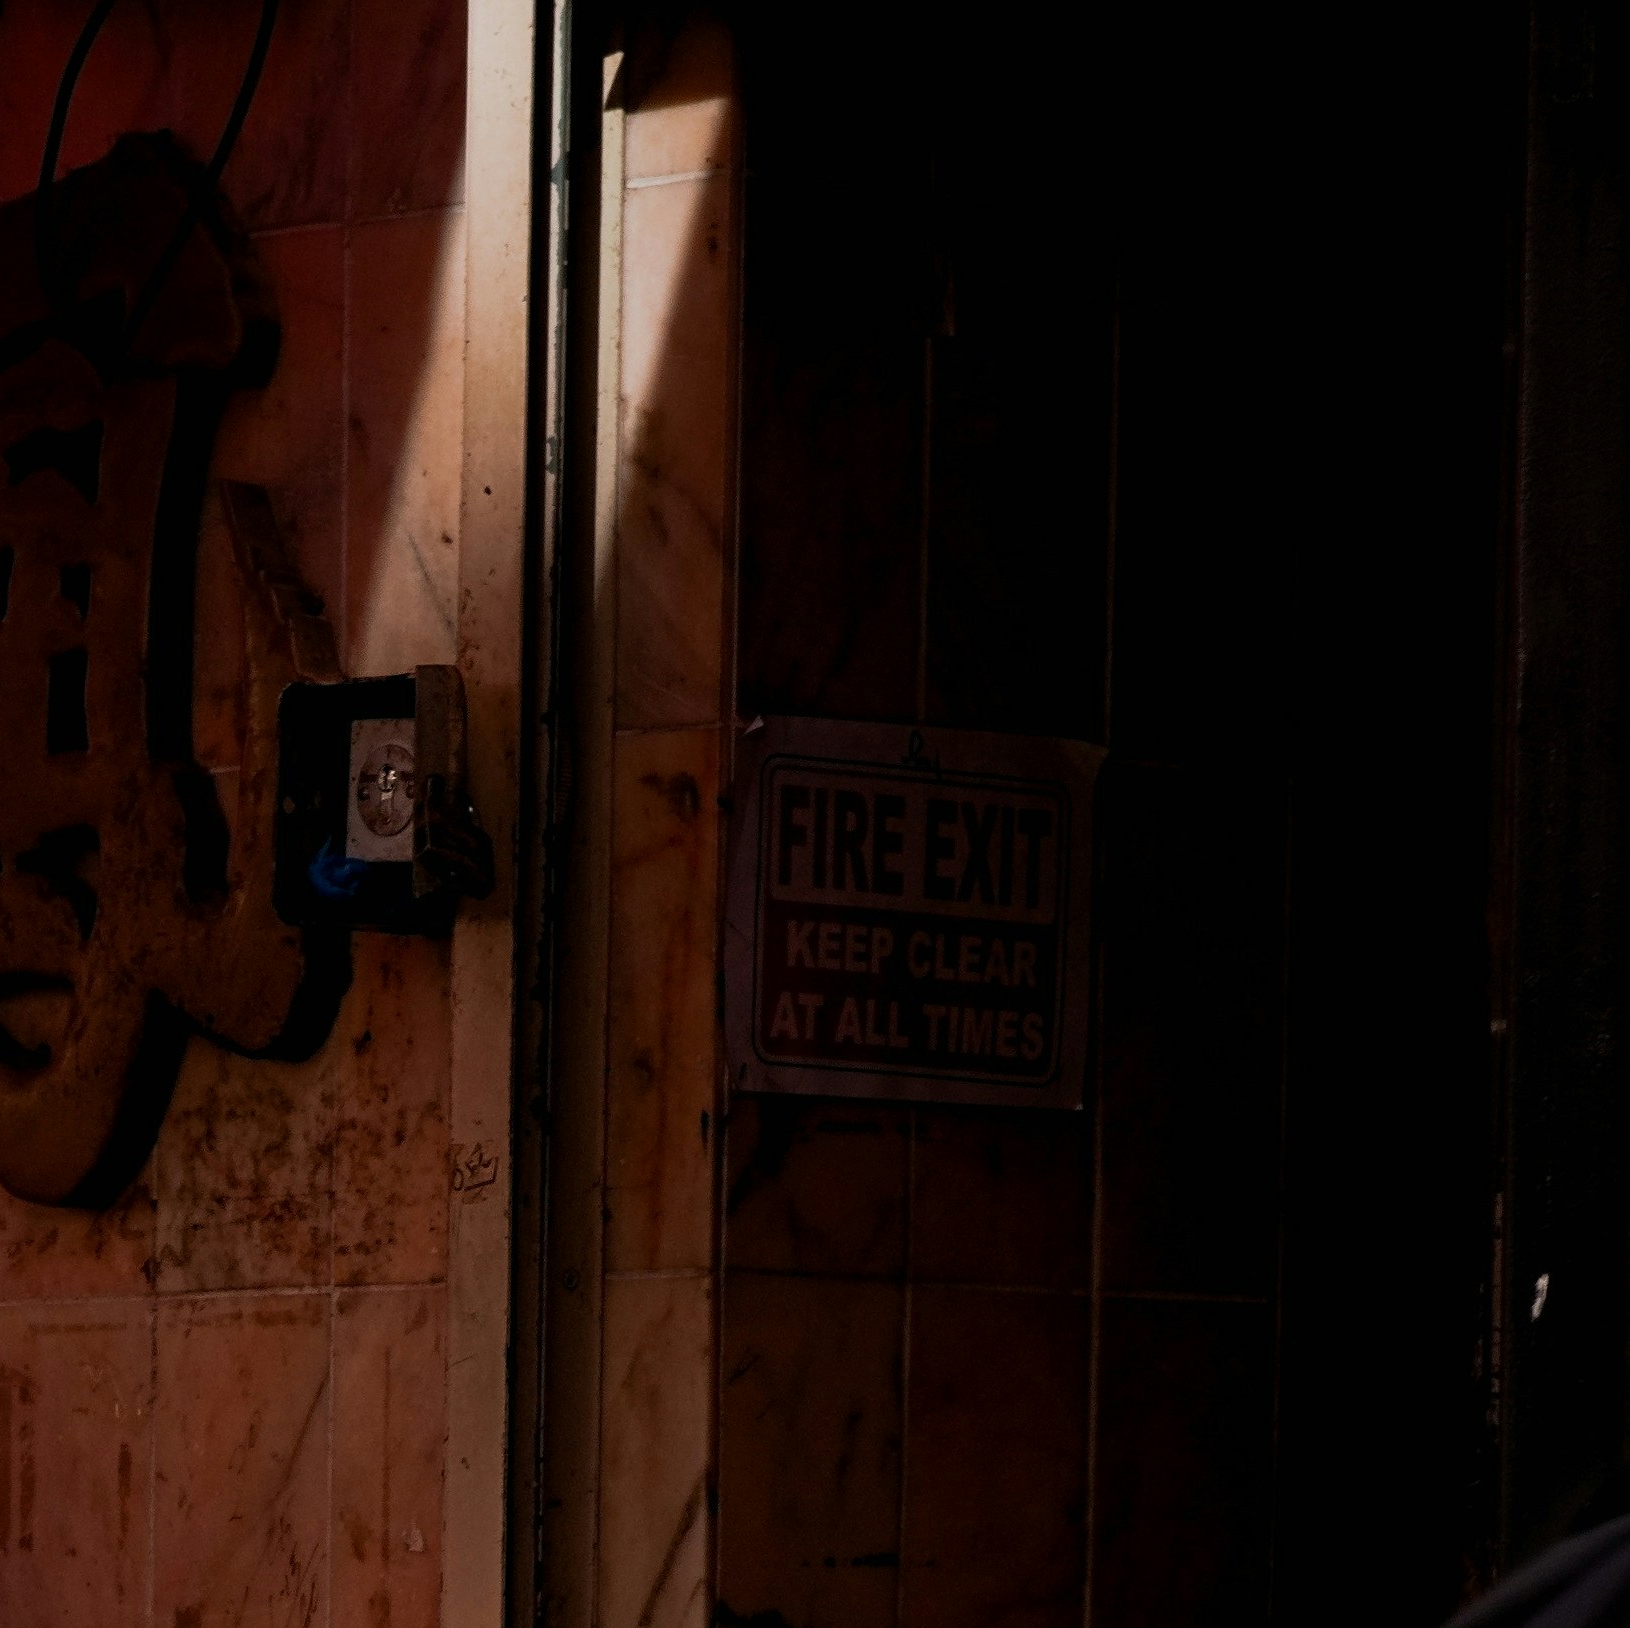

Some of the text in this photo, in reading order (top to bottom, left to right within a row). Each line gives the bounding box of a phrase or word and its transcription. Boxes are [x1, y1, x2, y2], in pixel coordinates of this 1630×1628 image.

[778, 785, 1051, 908] FIRE EXIT
[785, 919, 1037, 989] KEEP CLEAR
[769, 991, 1045, 1061] AT ALL TIMES
